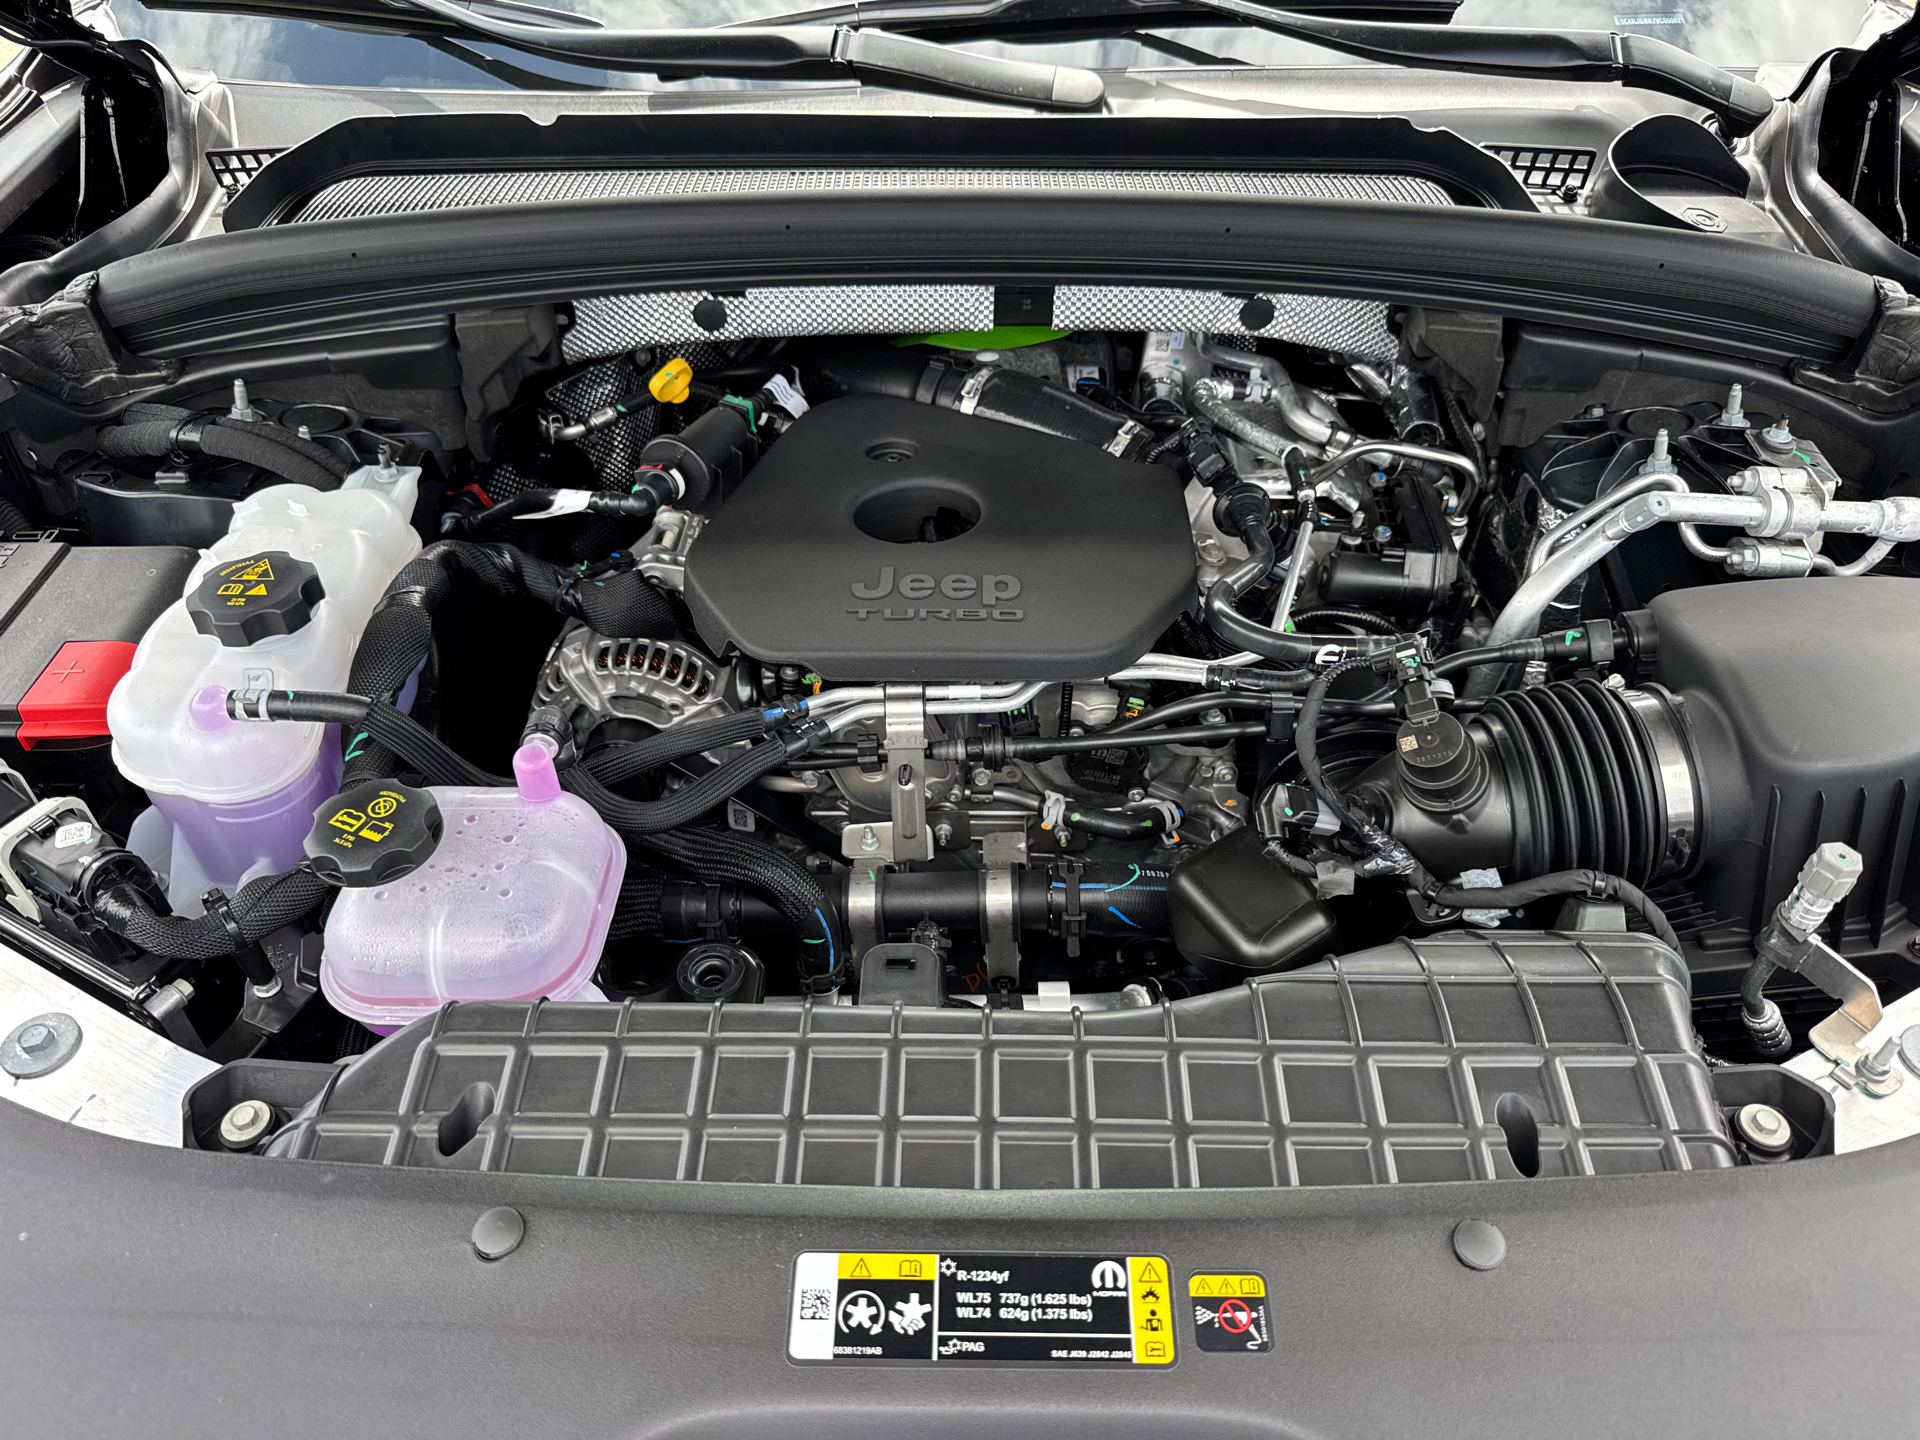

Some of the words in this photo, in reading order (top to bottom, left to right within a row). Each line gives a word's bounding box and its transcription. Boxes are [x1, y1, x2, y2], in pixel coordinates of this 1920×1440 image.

[851, 566, 1021, 607] Jeep
[846, 608, 1024, 622] TURBO
[956, 1270, 1010, 1284] R-1234yf
[956, 1292, 991, 1304] WL75
[999, 1293, 1029, 1307] 737g
[1031, 1293, 1067, 1307] (1.625
[1069, 1293, 1093, 1308] lbs)
[956, 1307, 992, 1319] WL74
[999, 1308, 1029, 1322] 624g
[1031, 1308, 1067, 1322] (1.375
[1069, 1308, 1093, 1323] lbs)
[833, 1346, 883, 1355] 68381219AB
[961, 1341, 985, 1352] PAG
